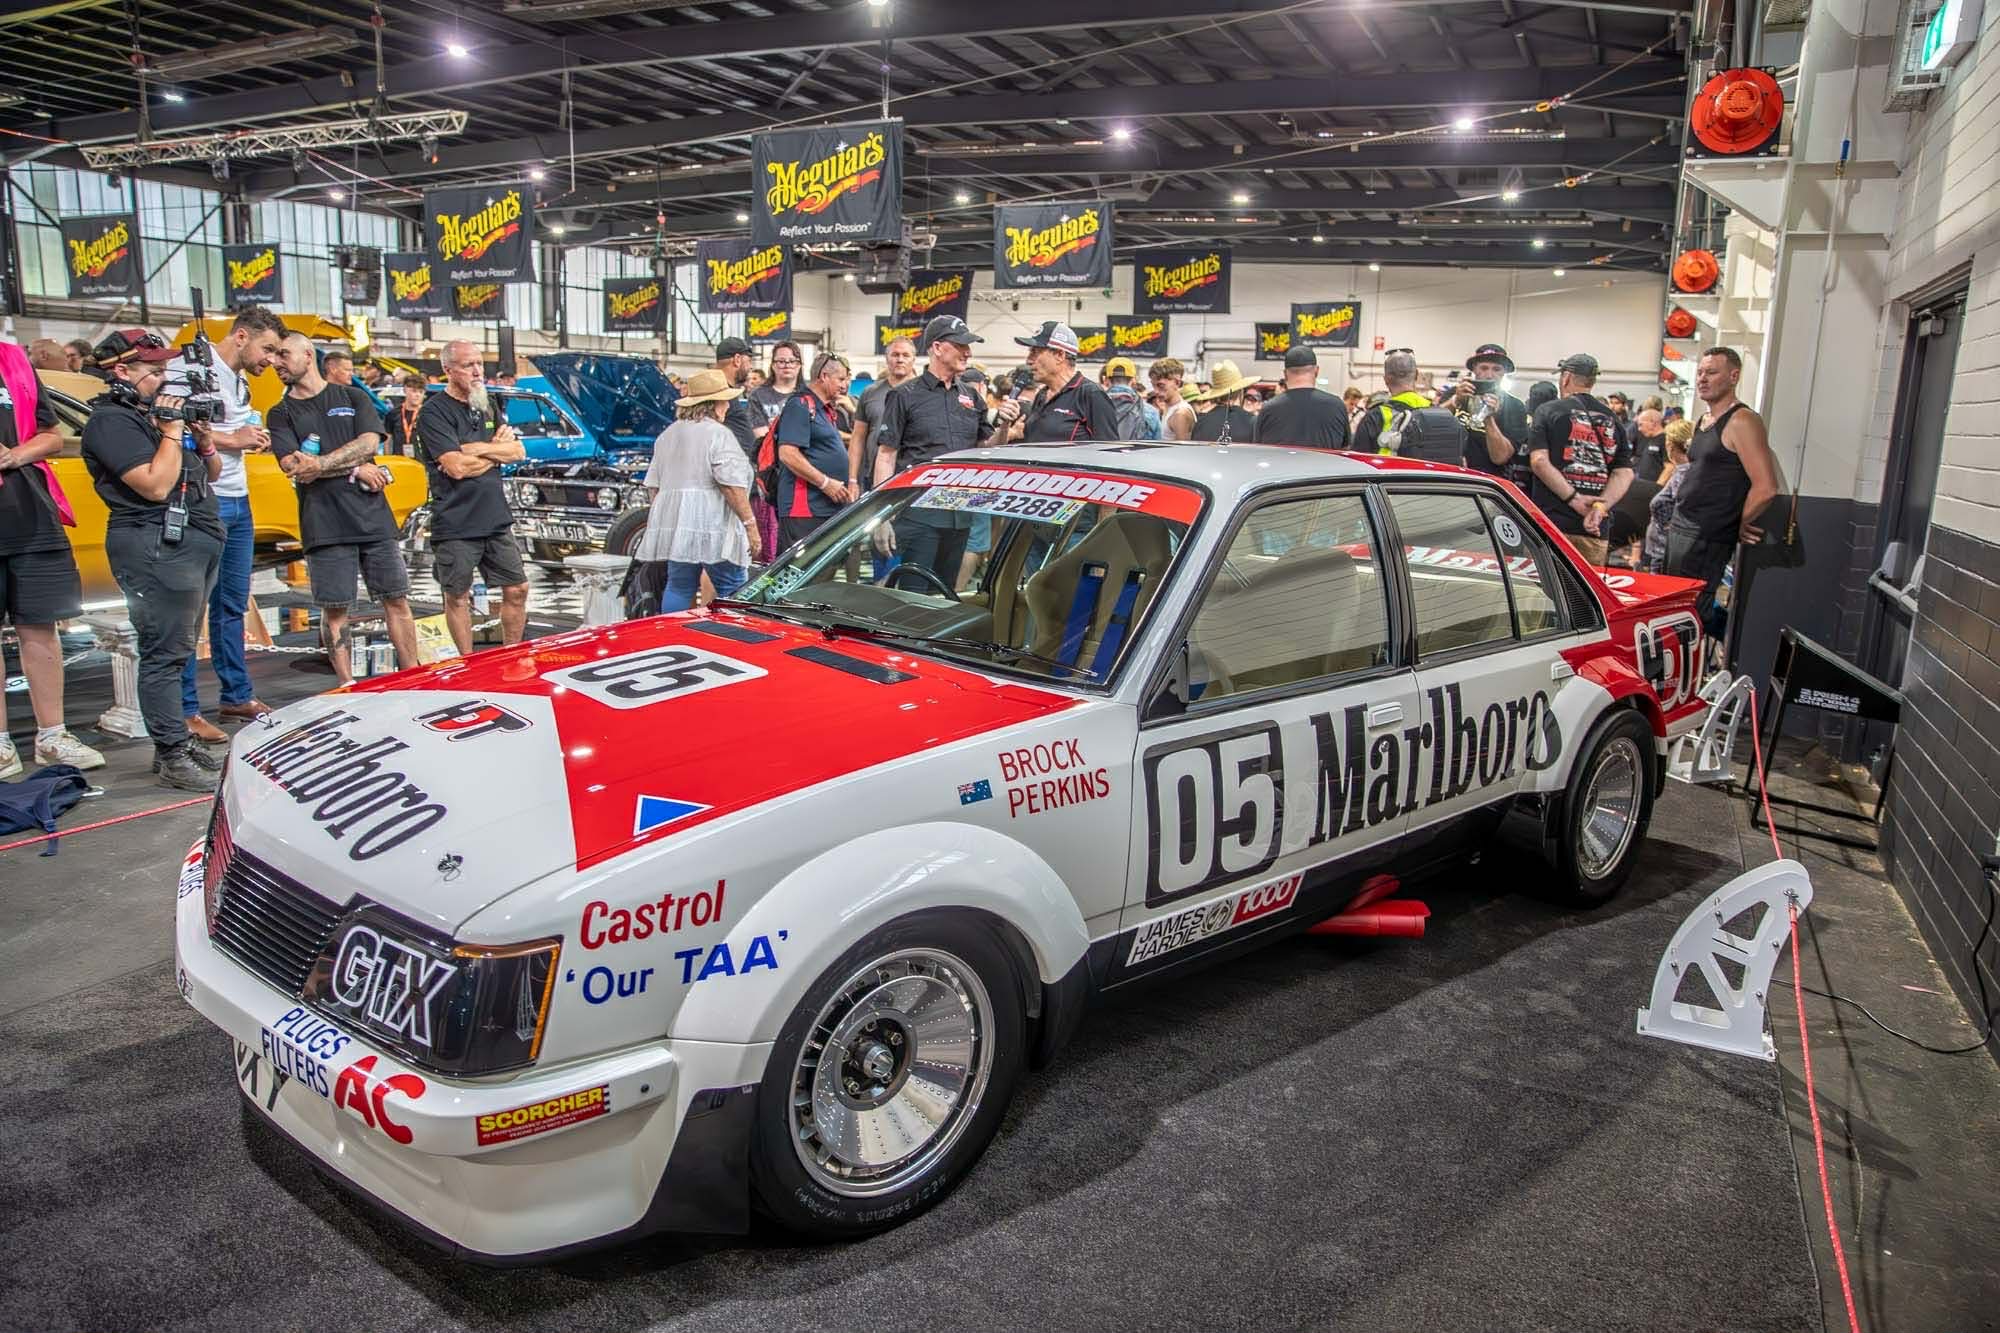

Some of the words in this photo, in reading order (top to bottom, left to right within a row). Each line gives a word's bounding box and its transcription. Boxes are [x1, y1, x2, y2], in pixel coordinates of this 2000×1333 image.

[767, 131, 885, 216] Meguiar's
[69, 220, 129, 279] Meguiar's
[436, 190, 523, 261] Meguiar's
[780, 225, 812, 239] Reflect
[814, 223, 834, 234] Your
[1005, 208, 1099, 268] Meguiar's
[227, 248, 276, 290] Meguiar's
[707, 244, 784, 295] Meguiar's
[1144, 253, 1221, 298] Meguiar's
[609, 282, 661, 319] Meguiar's
[1296, 305, 1354, 338] Meguiar's
[911, 468, 1156, 508] COMMODORE
[993, 495, 1065, 518] 3288
[1501, 522, 1515, 538] 65
[567, 651, 748, 700] 05
[998, 738, 1086, 782] BROCK
[1308, 681, 1563, 849] Marlboro
[240, 710, 447, 861] Marlboro
[1008, 768, 1110, 818] PERKINS
[1156, 733, 1277, 895] 05
[580, 879, 726, 950] Castrol
[1241, 878, 1294, 915] 1000
[1131, 926, 1200, 964] HARDIE
[1140, 907, 1206, 945] JAMES
[332, 925, 458, 1048] GTX
[273, 1007, 351, 1060] PLUGS
[261, 1026, 330, 1099] FILTERS
[334, 1055, 427, 1145] AC
[479, 1087, 603, 1132] SCORCHER
